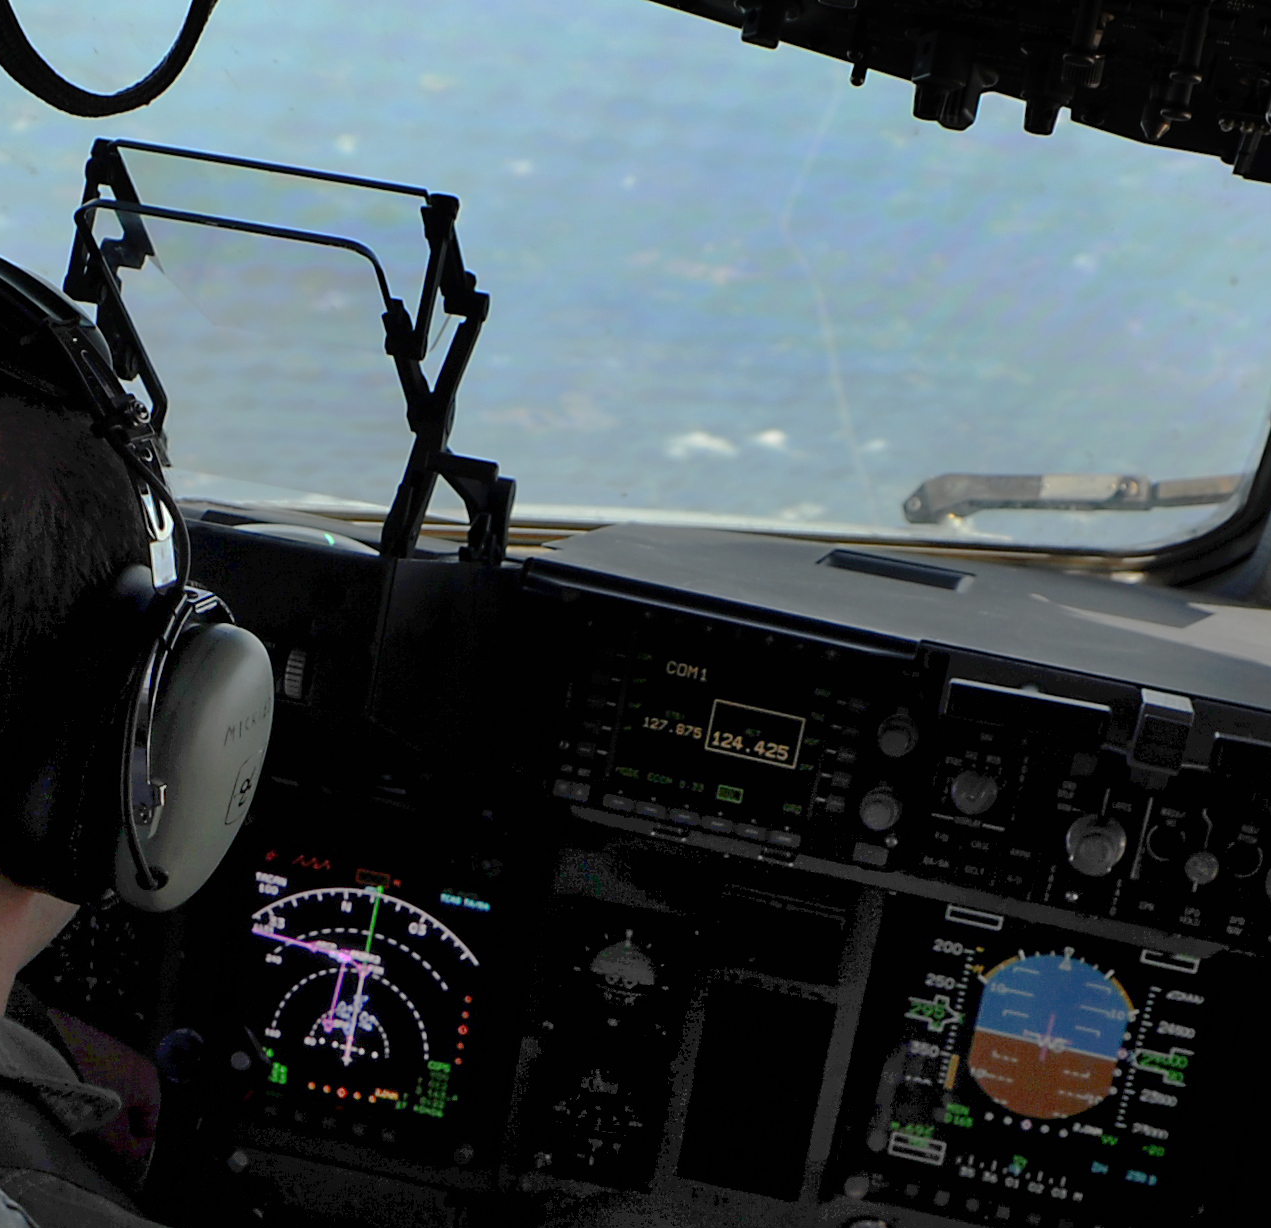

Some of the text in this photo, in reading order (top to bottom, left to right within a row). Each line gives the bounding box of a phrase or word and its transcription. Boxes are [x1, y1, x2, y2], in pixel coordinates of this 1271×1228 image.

[666, 660, 708, 683] COM1
[642, 716, 704, 741] 127.875
[712, 731, 791, 762] 124.425
[932, 938, 964, 956] 200
